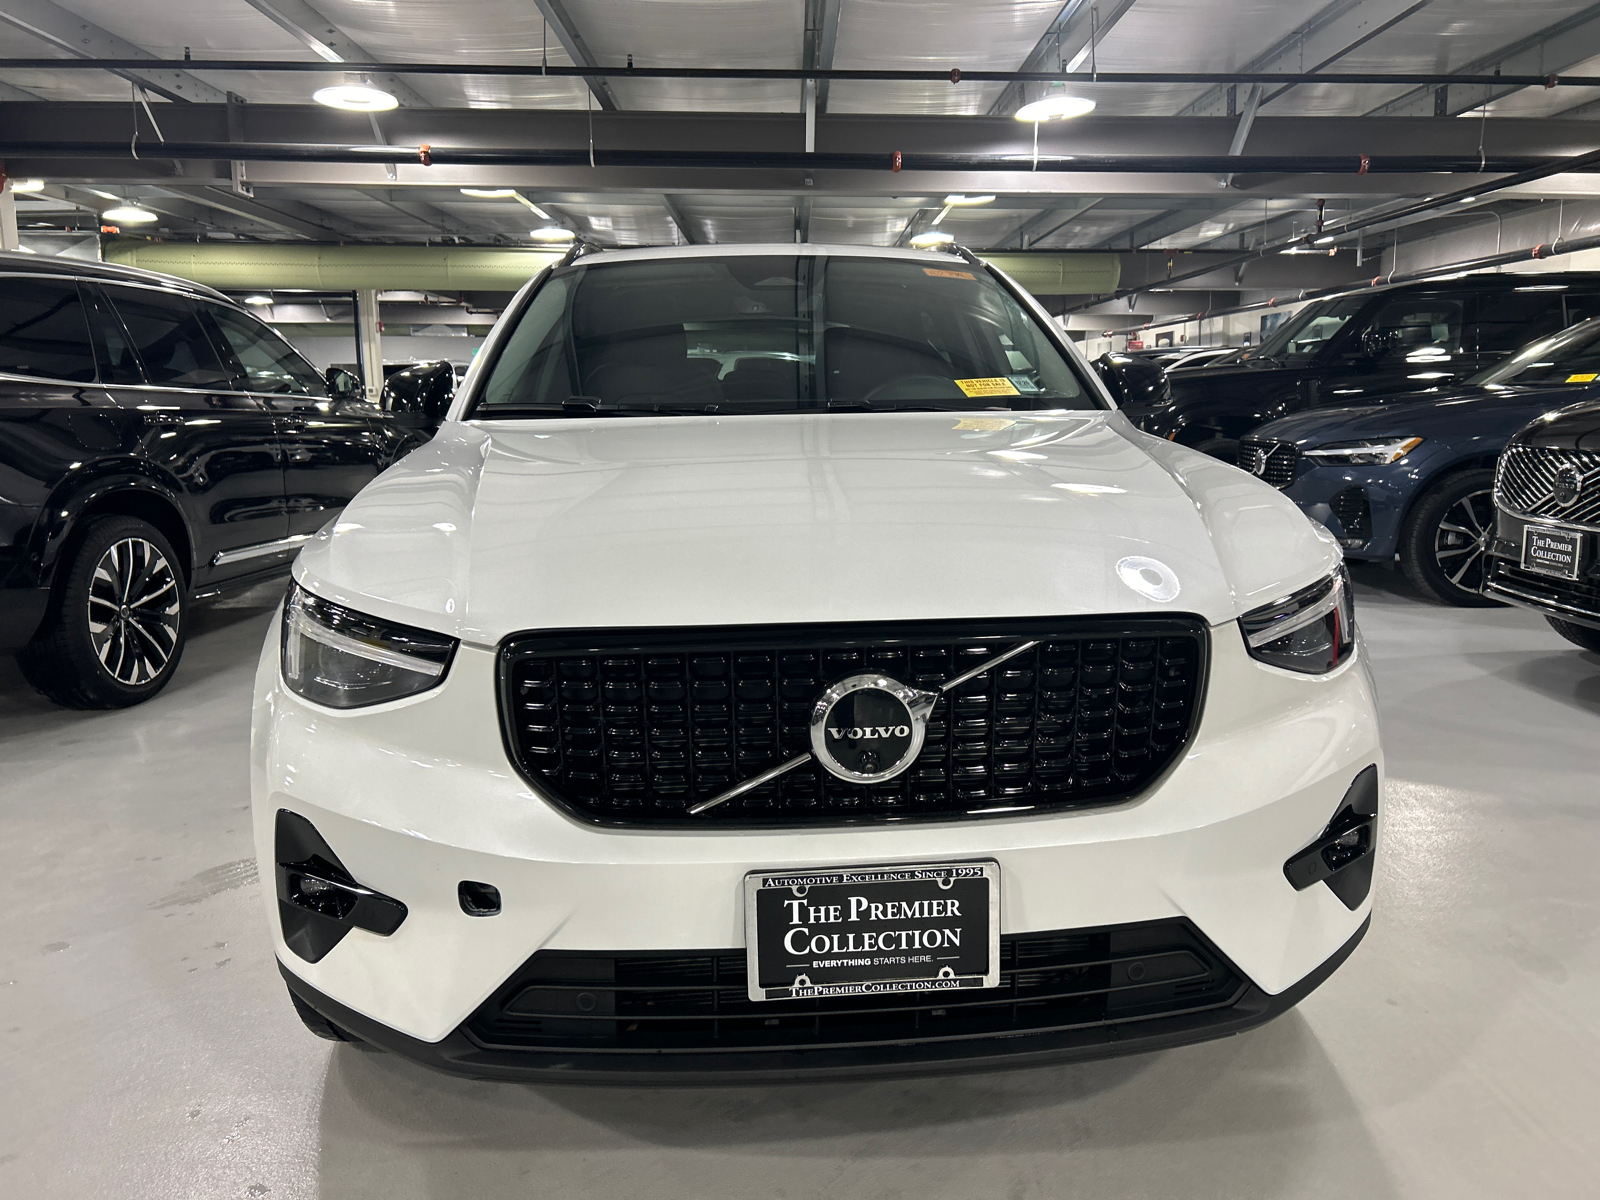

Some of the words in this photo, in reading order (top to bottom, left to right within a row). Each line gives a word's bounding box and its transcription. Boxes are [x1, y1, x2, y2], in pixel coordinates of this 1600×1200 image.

[1532, 536, 1545, 548] THE
[1545, 538, 1572, 552] PREMIER
[1531, 546, 1572, 563] COLLECTION
[828, 725, 910, 740] VOLVO
[765, 876, 839, 887] AUTOMOTIVE
[842, 872, 912, 883] EXCELLENCE
[914, 870, 948, 879] SINCE
[951, 867, 982, 877] 1995
[783, 898, 843, 925] THE
[847, 896, 962, 922] PREMIER
[783, 927, 962, 955] COLLECTION
[812, 958, 872, 968] EVERYTHING
[873, 957, 906, 965] STARTS
[907, 955, 934, 963] HERE.
